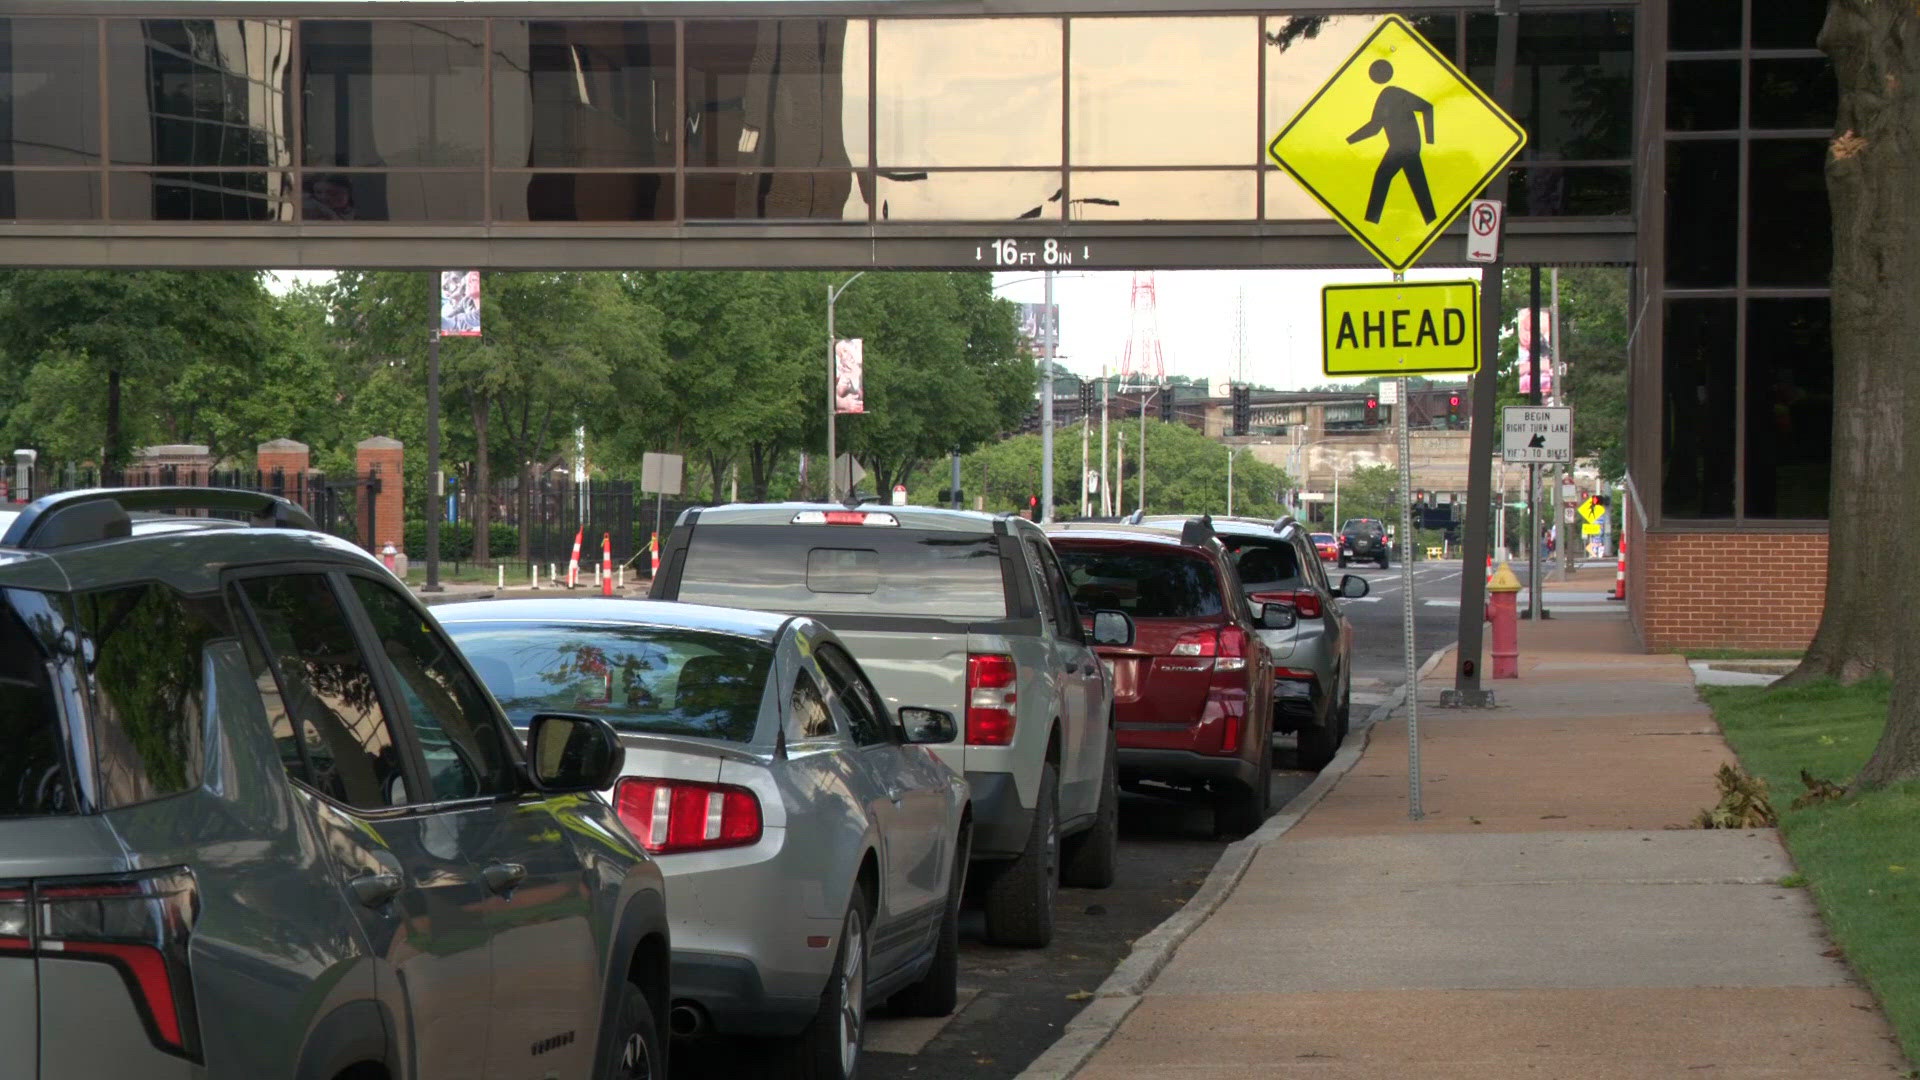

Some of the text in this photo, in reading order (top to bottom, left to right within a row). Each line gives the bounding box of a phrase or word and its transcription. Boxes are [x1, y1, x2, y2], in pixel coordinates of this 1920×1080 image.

[1335, 308, 1466, 349] AHEAD
[1524, 412, 1550, 421] BEGIN
[1506, 424, 1568, 433] RIGHT TURN LANE
[1507, 449, 1568, 458] YIED TO BIKES
